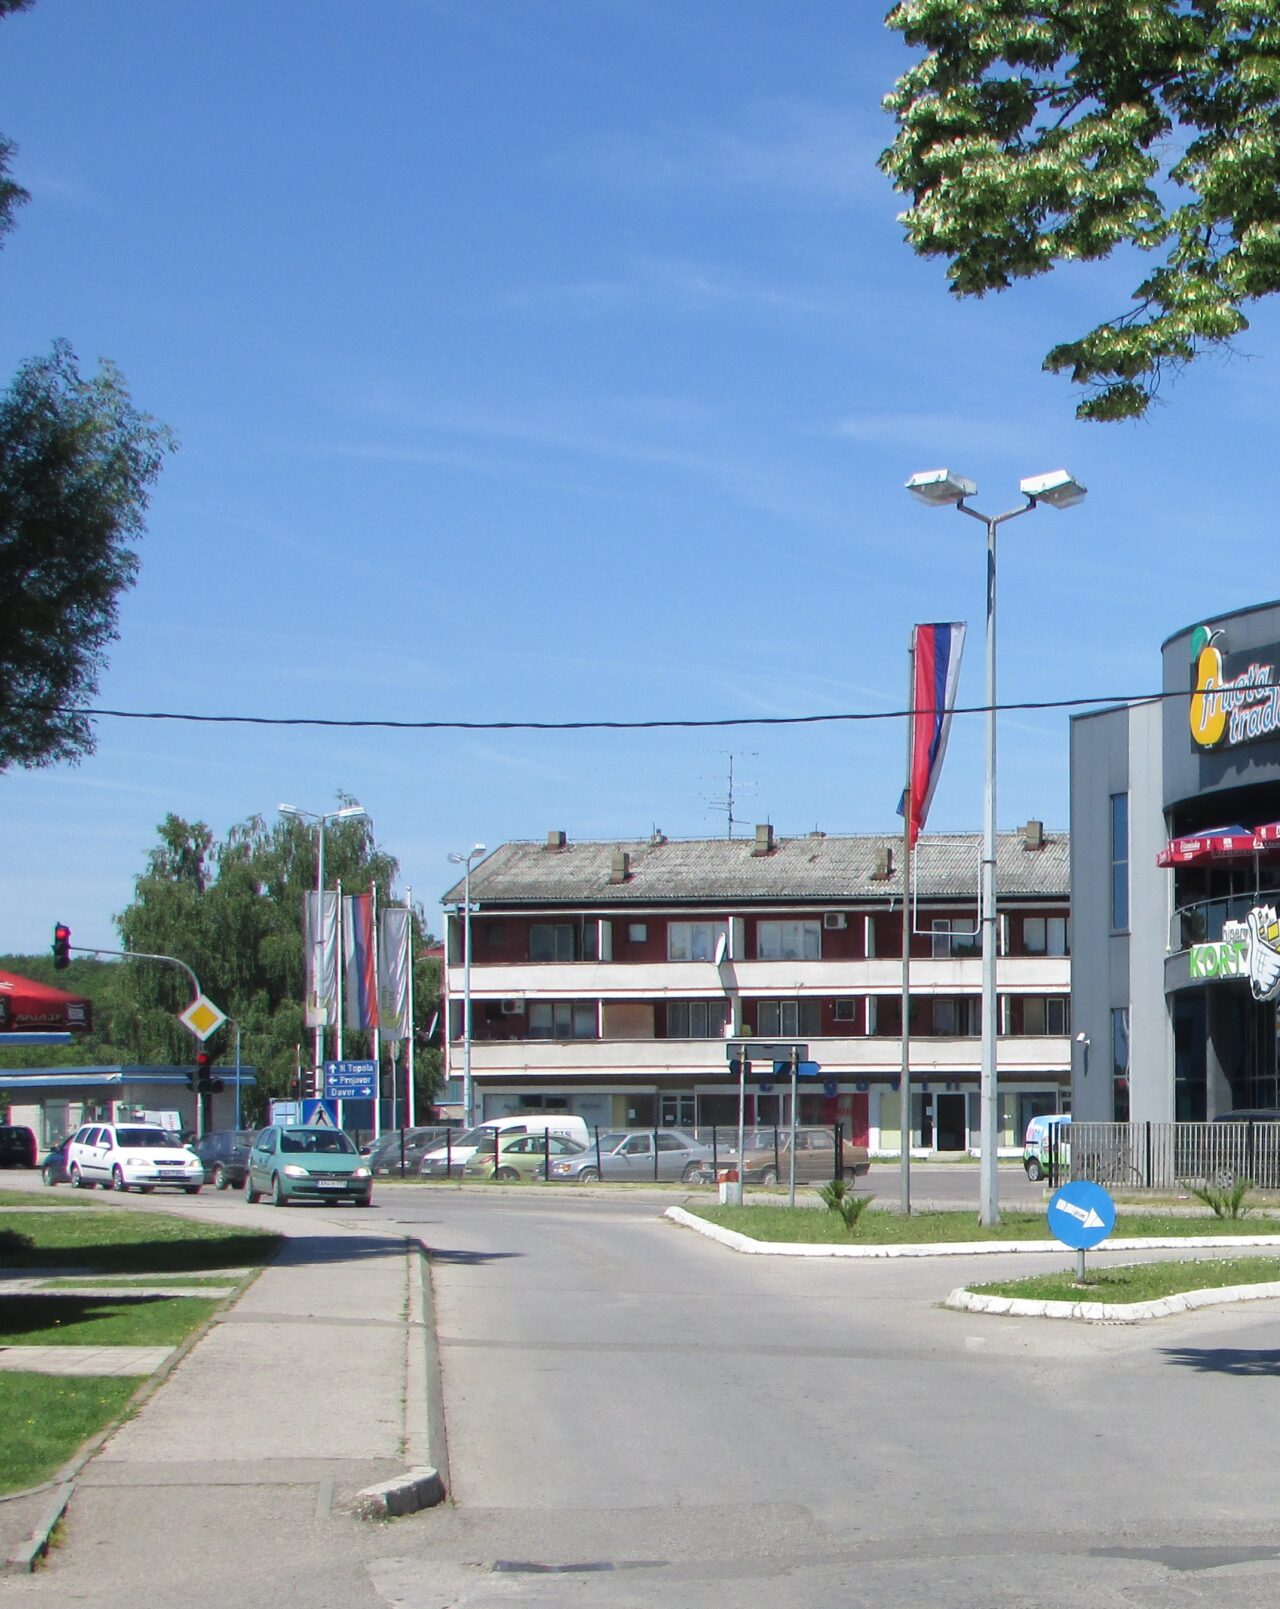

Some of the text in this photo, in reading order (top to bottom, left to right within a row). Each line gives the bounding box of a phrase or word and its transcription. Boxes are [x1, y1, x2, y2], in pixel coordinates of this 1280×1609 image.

[1199, 664, 1272, 732] fructa
[348, 1064, 374, 1074] Topola
[332, 1088, 355, 1097] Davor
